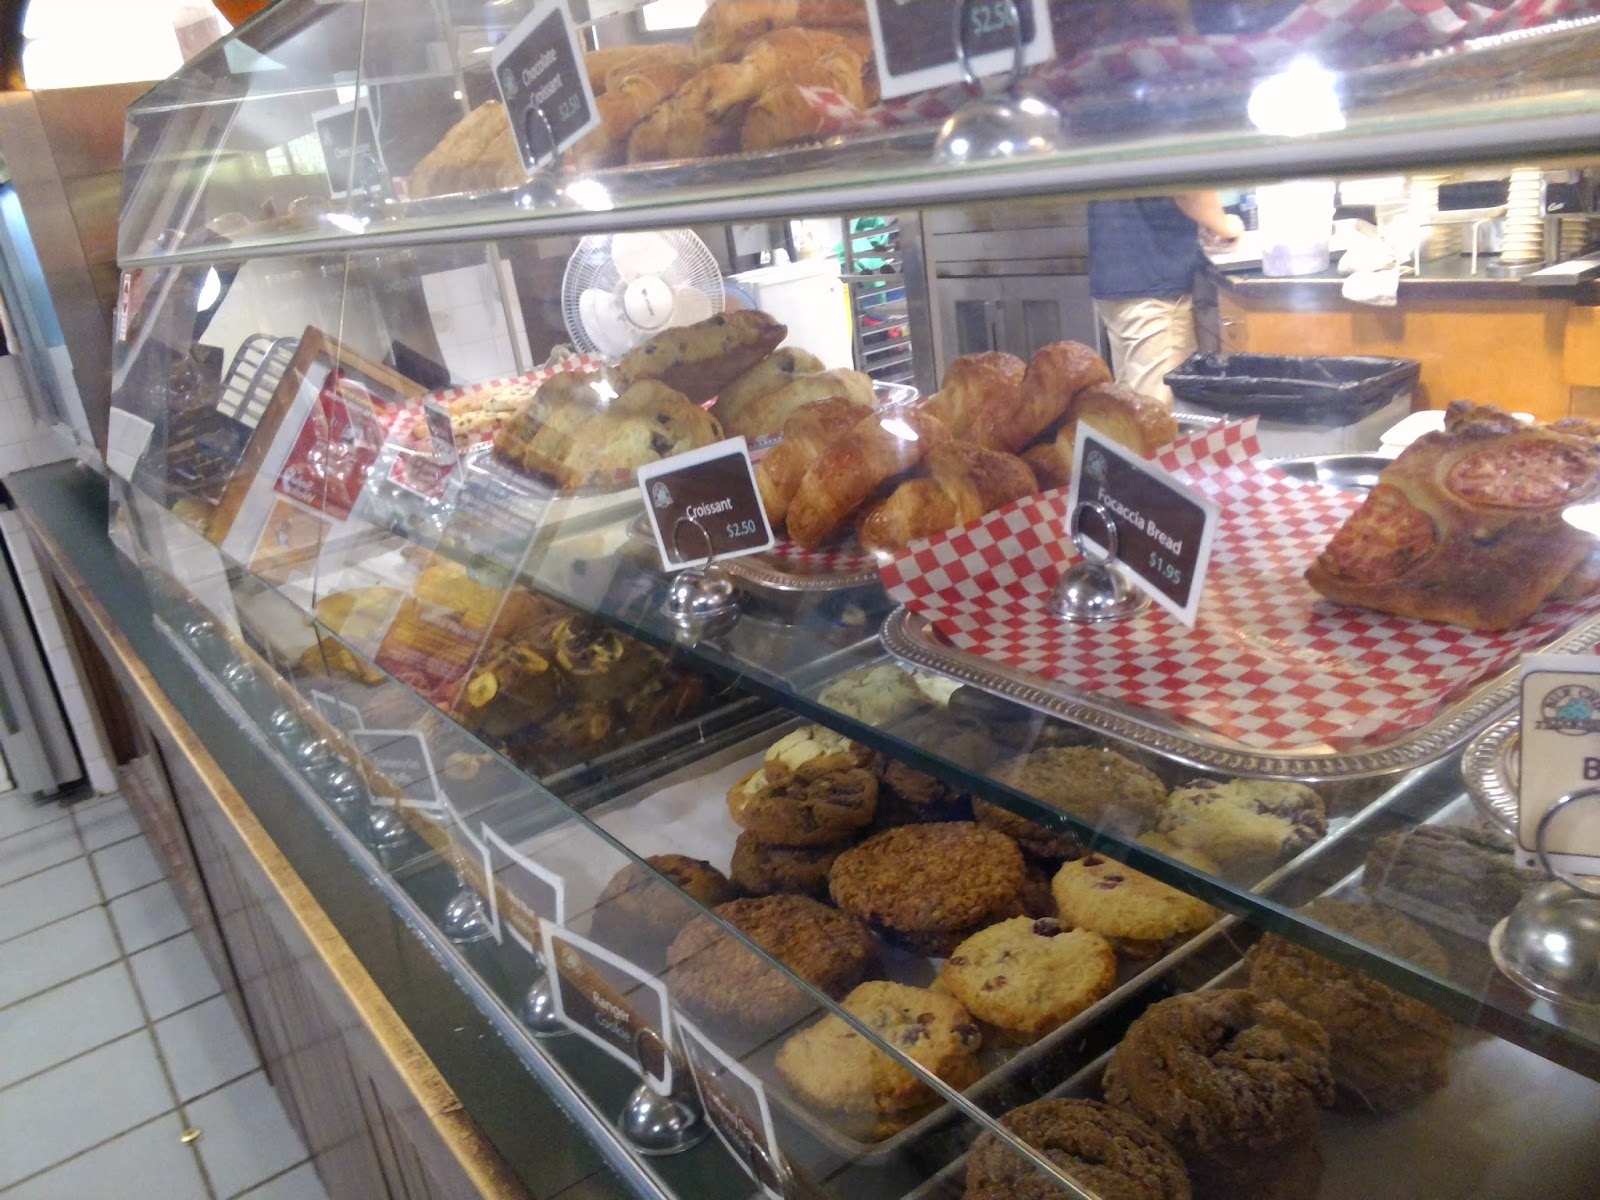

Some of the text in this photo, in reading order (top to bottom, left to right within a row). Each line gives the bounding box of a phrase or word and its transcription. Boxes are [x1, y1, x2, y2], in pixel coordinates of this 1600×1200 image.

[685, 497, 734, 519] Croissant
[726, 519, 756, 539] $2.50
[1097, 487, 1183, 557] Focaccia Bread
[1150, 552, 1182, 585] $1.95
